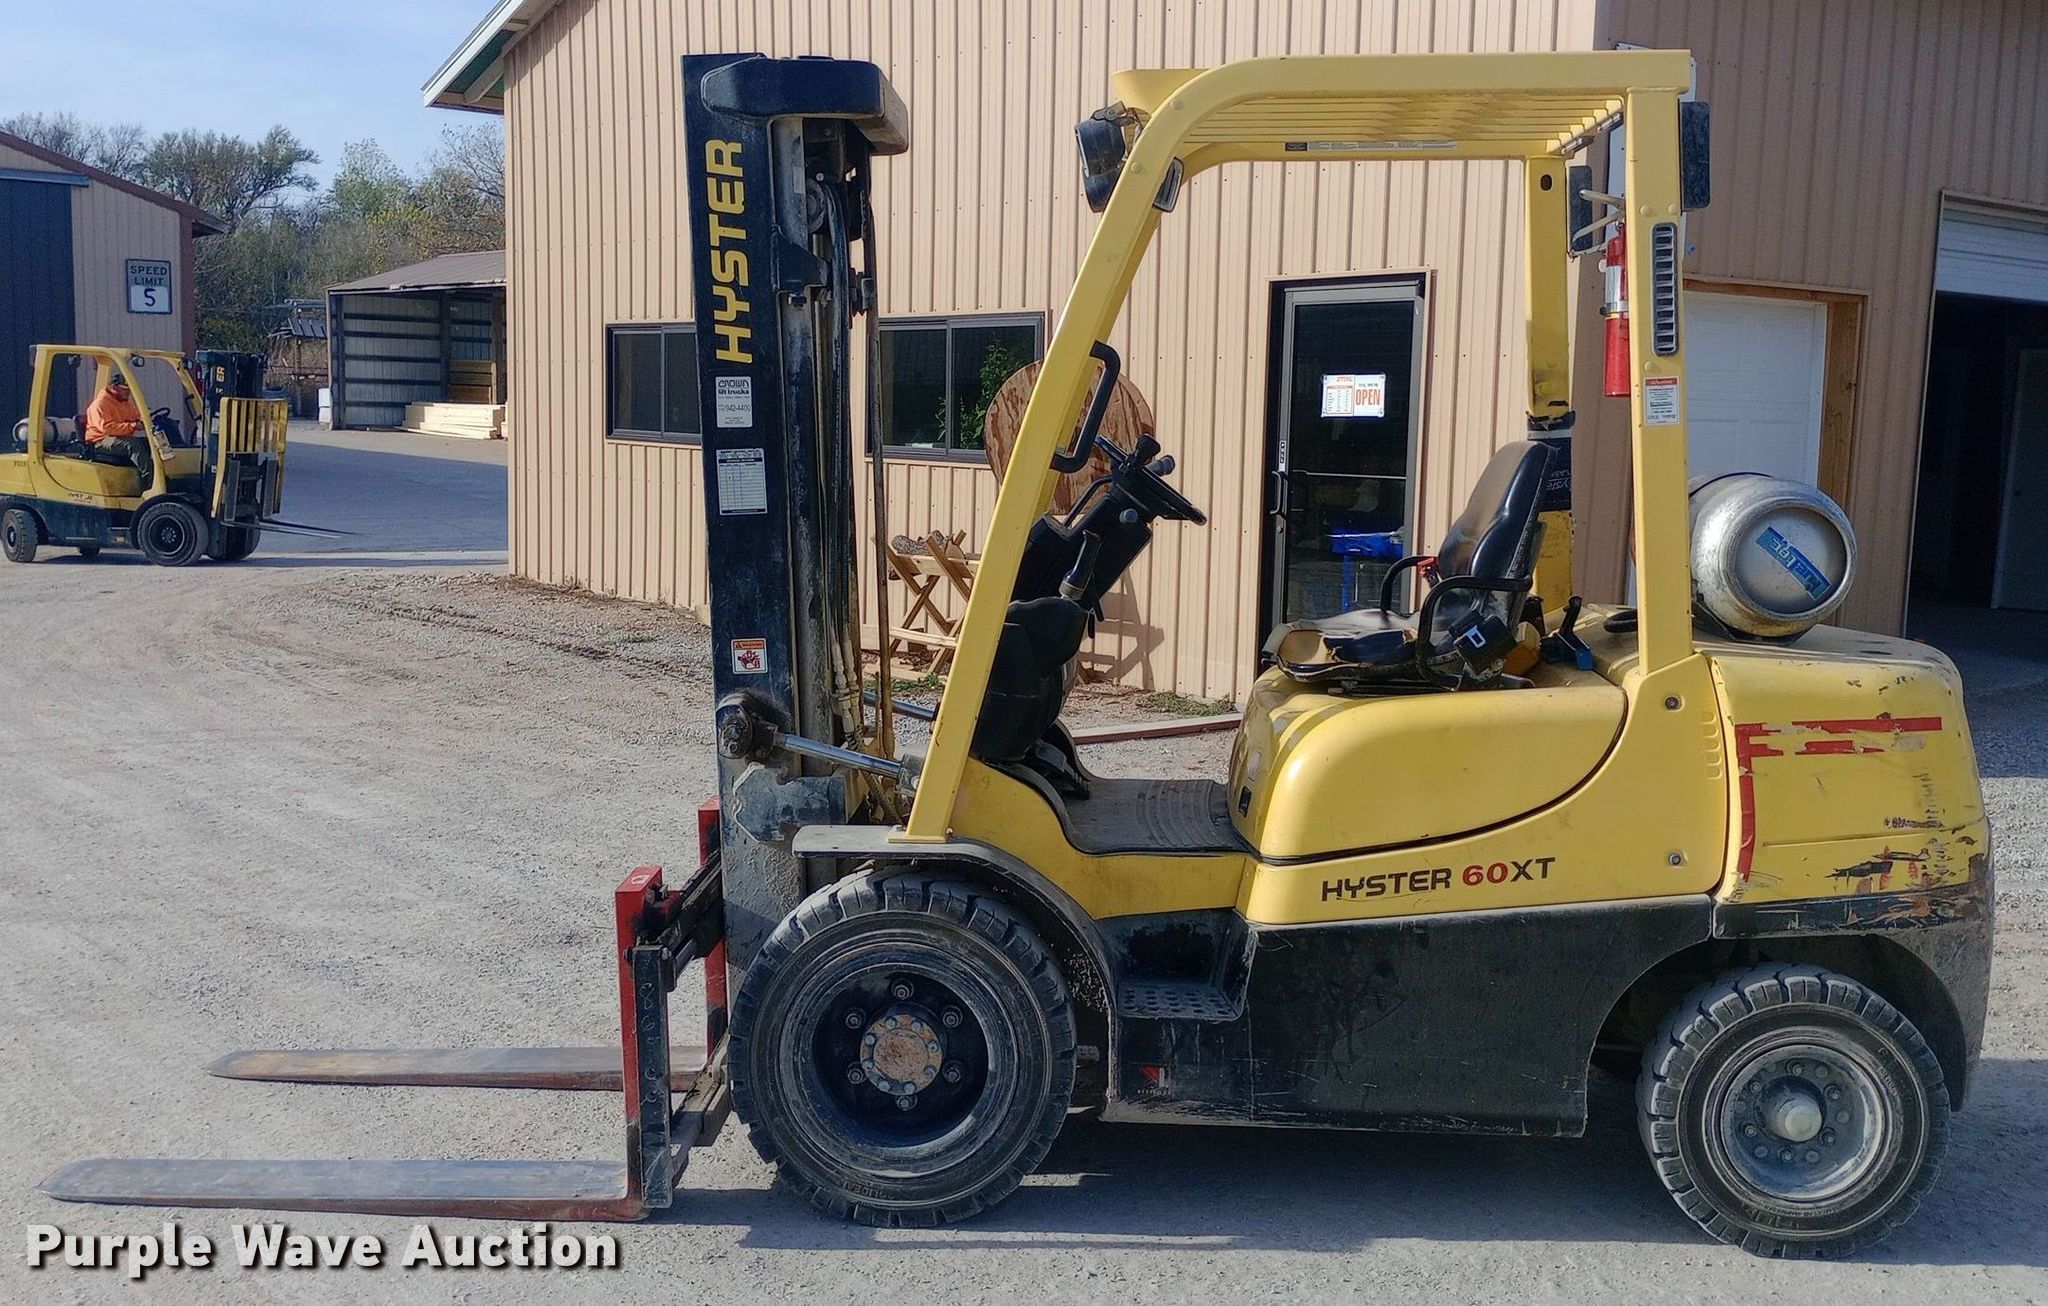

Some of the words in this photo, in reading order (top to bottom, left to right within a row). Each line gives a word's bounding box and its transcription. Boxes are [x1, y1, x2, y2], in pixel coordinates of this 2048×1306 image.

[704, 138, 753, 364] HYSTER
[130, 265, 168, 276] SPEED
[134, 276, 164, 287] LIMIT
[143, 287, 156, 307] 5
[1355, 388, 1381, 406] OPEN
[1321, 867, 1452, 902] HYSTER
[1462, 857, 1556, 887] 60XT
